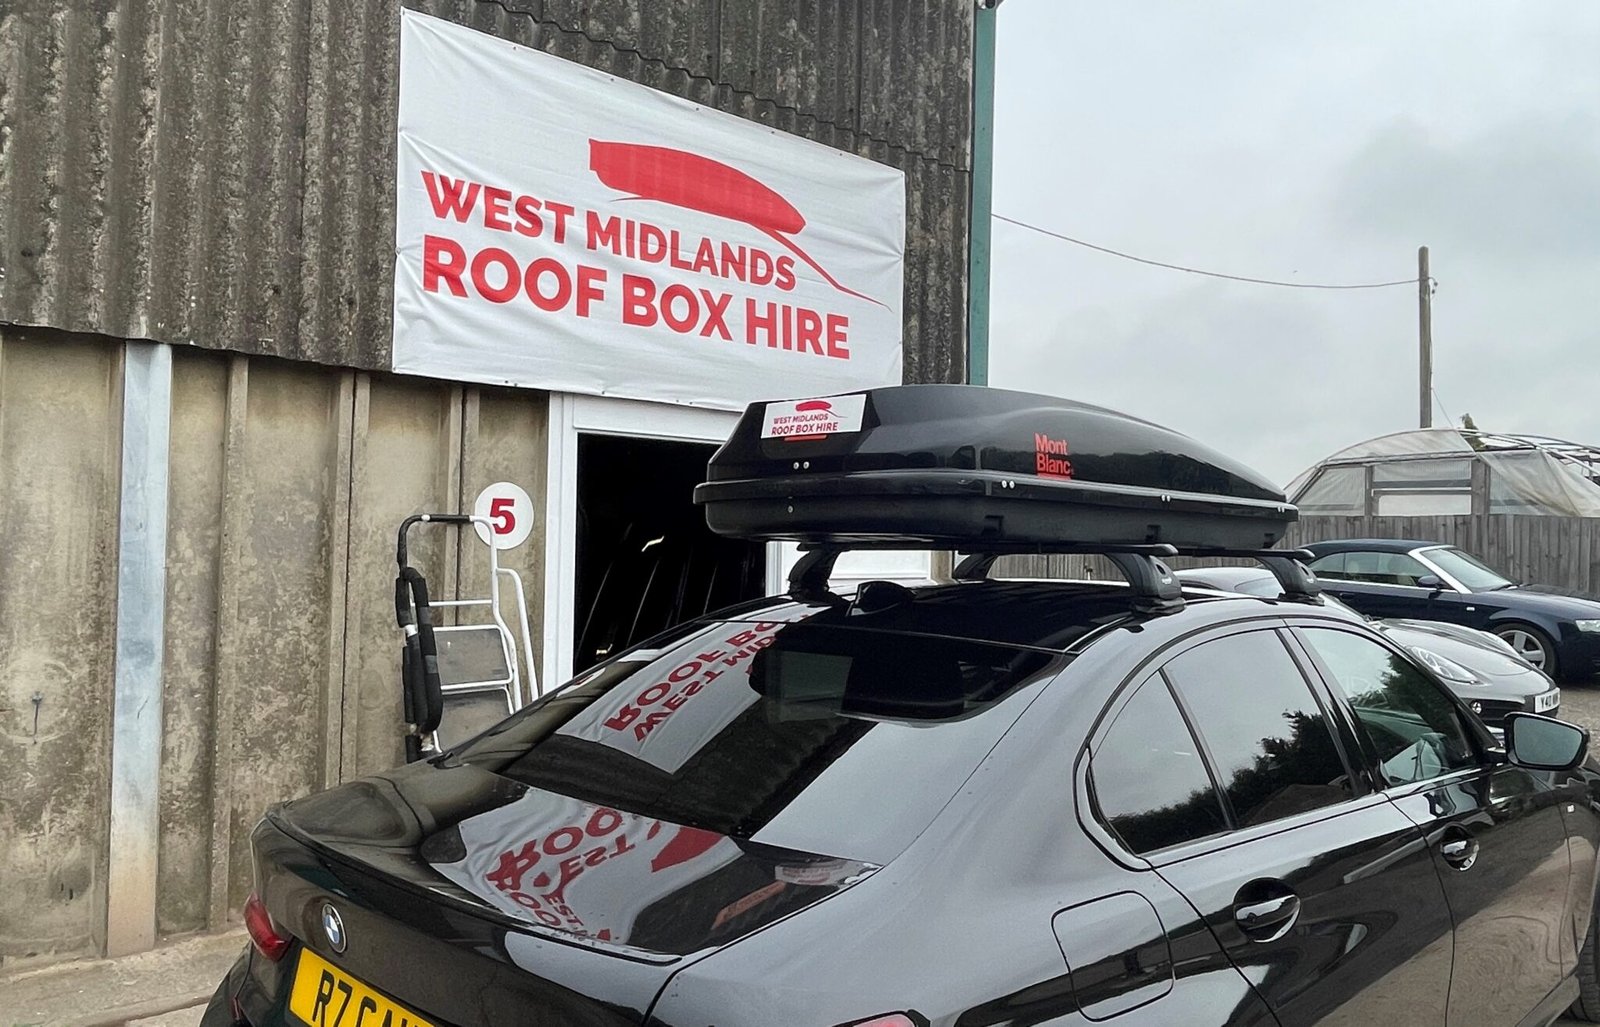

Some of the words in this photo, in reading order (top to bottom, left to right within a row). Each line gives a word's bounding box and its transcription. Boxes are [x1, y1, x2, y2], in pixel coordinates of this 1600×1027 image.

[420, 170, 575, 245] WEST
[585, 210, 797, 292] MIDLANDS
[422, 234, 608, 318] ROOF
[621, 273, 733, 341] BOX
[745, 297, 851, 360] HIRE
[771, 425, 795, 435] ROOF
[795, 423, 815, 433] BOX
[816, 422, 839, 432] HIRE
[773, 416, 792, 424] WEST
[792, 413, 829, 422] MIDLANDS
[1034, 432, 1068, 456] Mont
[489, 497, 516, 535] 5
